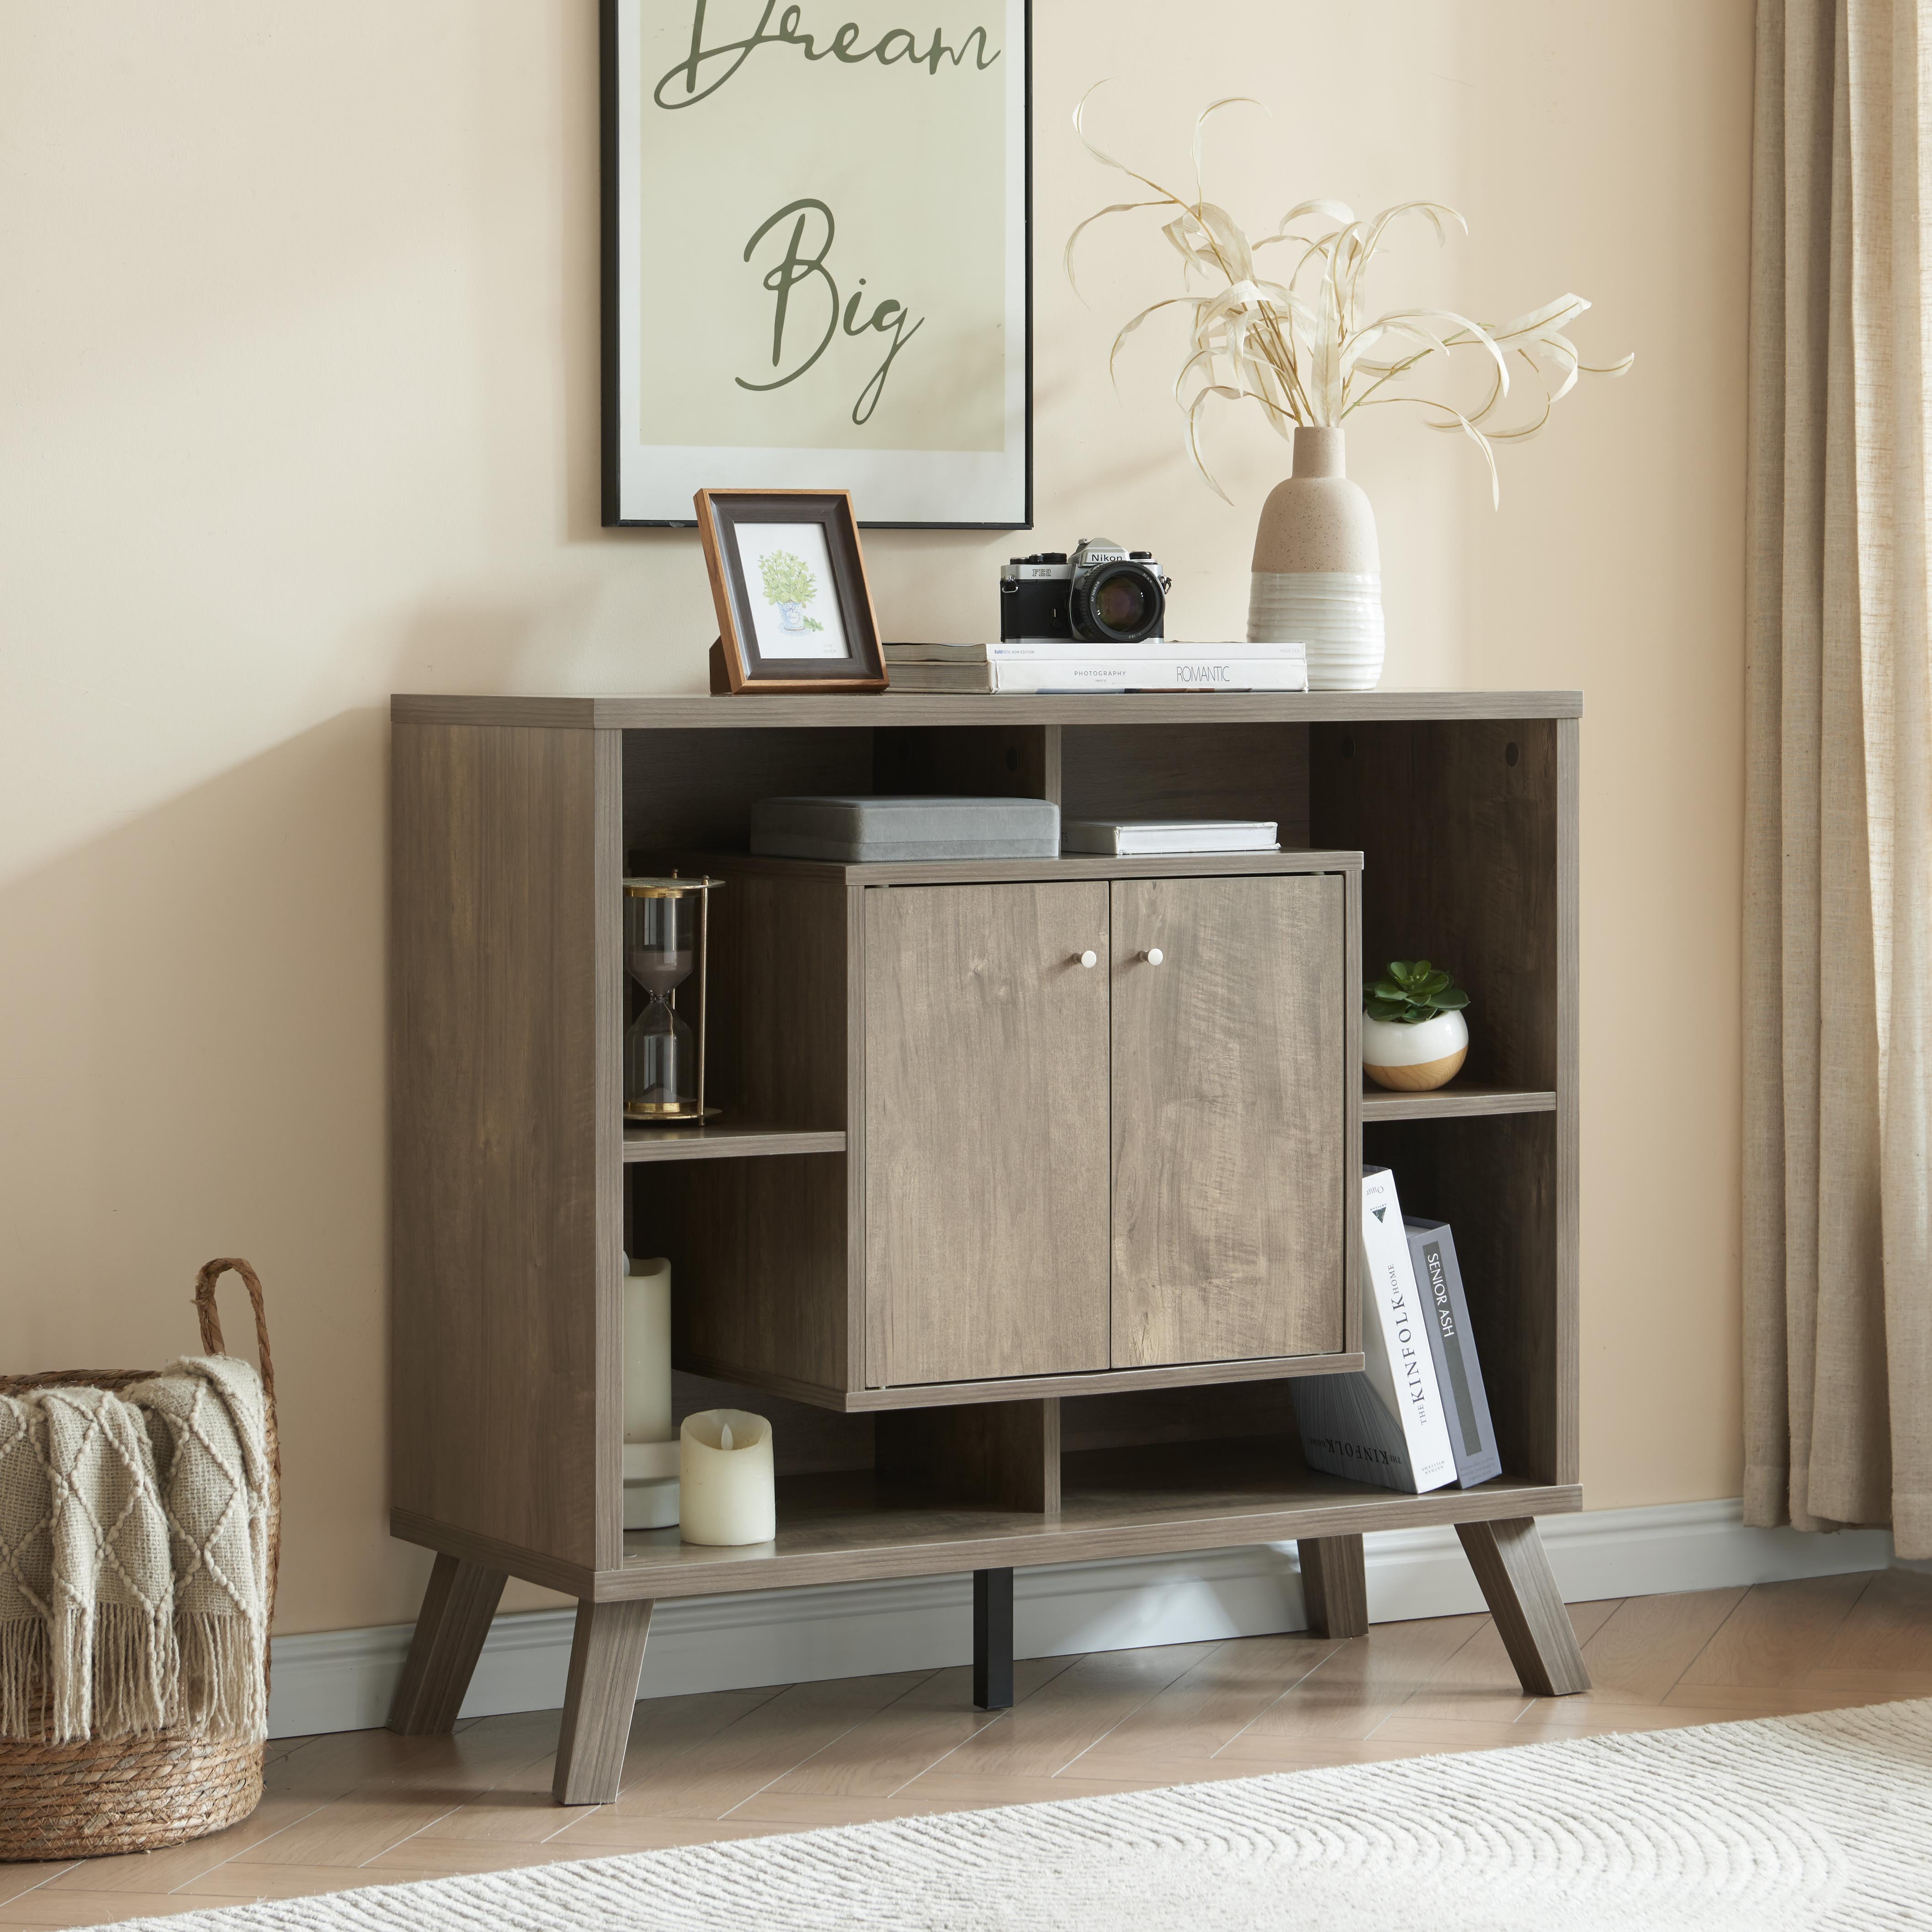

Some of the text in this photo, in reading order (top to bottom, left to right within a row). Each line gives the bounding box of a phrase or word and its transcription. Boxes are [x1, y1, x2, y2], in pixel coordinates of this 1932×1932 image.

[735, 198, 925, 425] Big
[1092, 581, 1100, 595] NIKKOR
[1177, 666, 1230, 682] ROMANTIC
[1366, 1186, 1384, 1195] Ouur
[1428, 1253, 1454, 1337] SENIOR ASH
[1388, 1264, 1427, 1425] THE KINFOLK HOME
[1325, 1438, 1389, 1465] KINFOLK
[1389, 1454, 1401, 1464] THE
